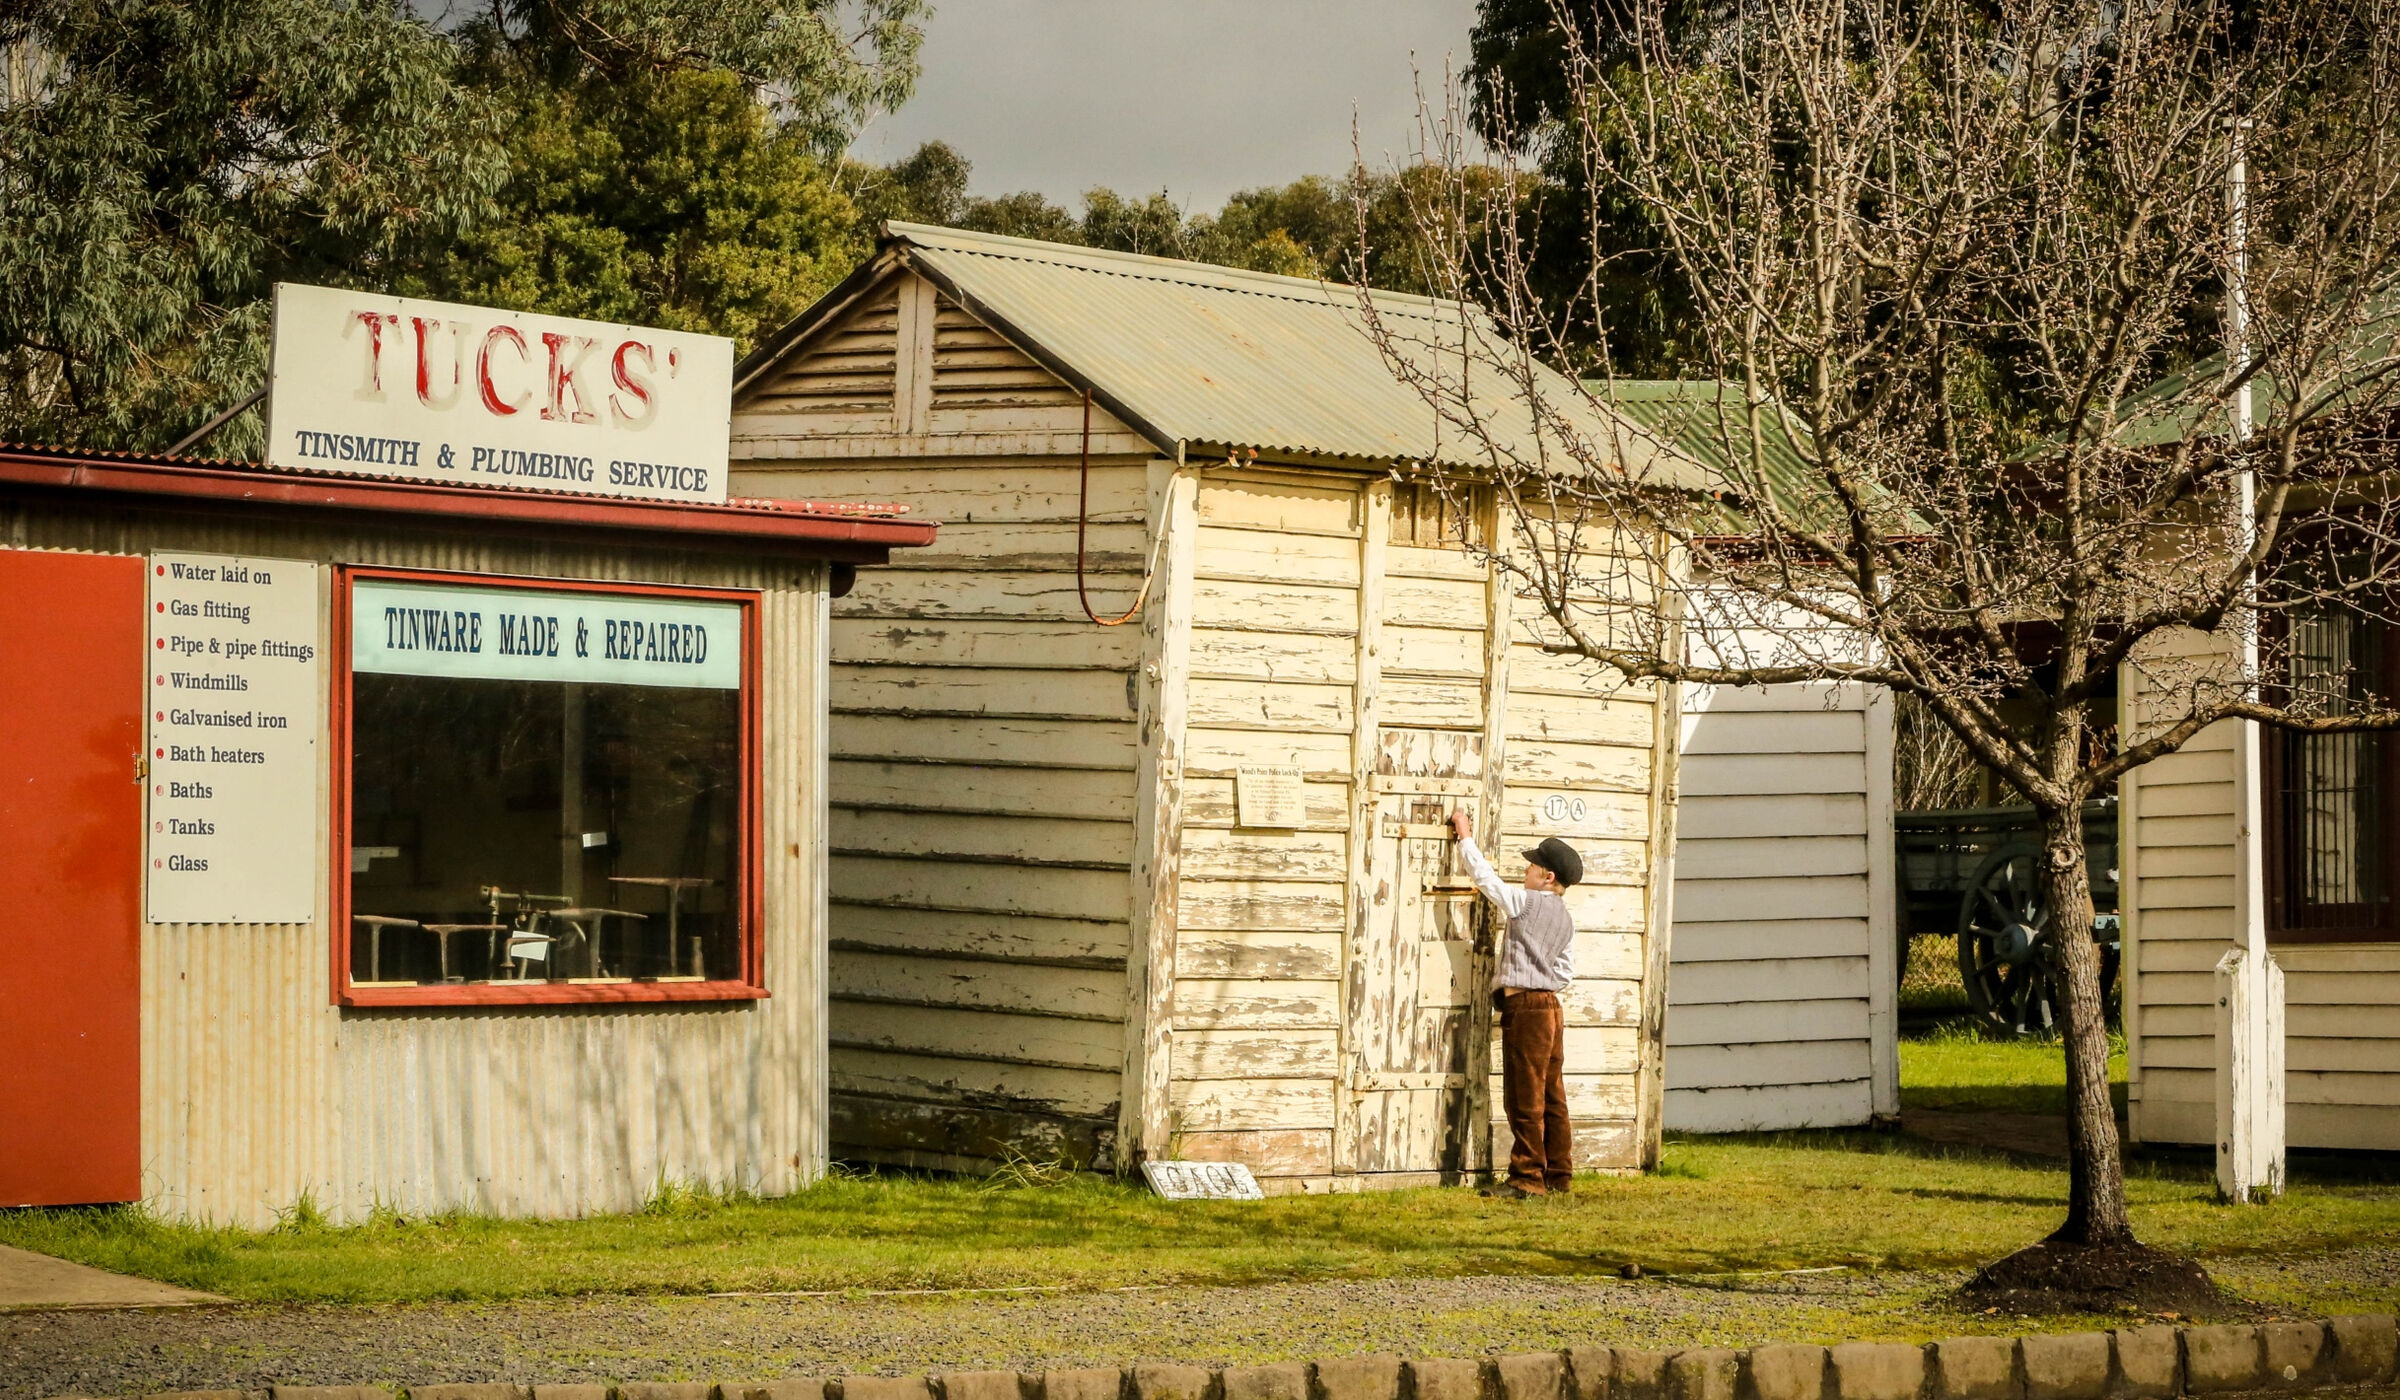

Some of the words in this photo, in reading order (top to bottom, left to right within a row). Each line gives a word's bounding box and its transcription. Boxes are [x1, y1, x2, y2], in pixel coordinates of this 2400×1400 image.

[342, 309, 682, 431] TUCKS'
[295, 430, 420, 467] TINSMITH
[436, 443, 455, 469] &
[471, 446, 594, 482] PLUMBING
[609, 460, 708, 492] SERVICE
[171, 563, 216, 581] Water
[221, 565, 248, 583] laid
[253, 571, 272, 585] on
[170, 599, 198, 616] Gas
[203, 600, 250, 624] fitting
[385, 607, 482, 653] TINWARE
[499, 614, 559, 657] MADE
[576, 616, 588, 658] &
[605, 619, 707, 664] REPAIRED
[170, 636, 203, 657] Pipe
[208, 637, 220, 654] &
[226, 638, 257, 659] pipe
[261, 639, 314, 663] fittings
[170, 672, 248, 691] Windmills
[170, 709, 252, 728] Galvanised
[257, 712, 287, 728] iron
[170, 745, 206, 762] Bath
[211, 746, 265, 764] heaters
[170, 782, 213, 798] Baths
[1551, 799, 1562, 815] 17
[1575, 802, 1583, 815] A
[169, 818, 215, 835] Tanks
[168, 855, 208, 871] Glass
